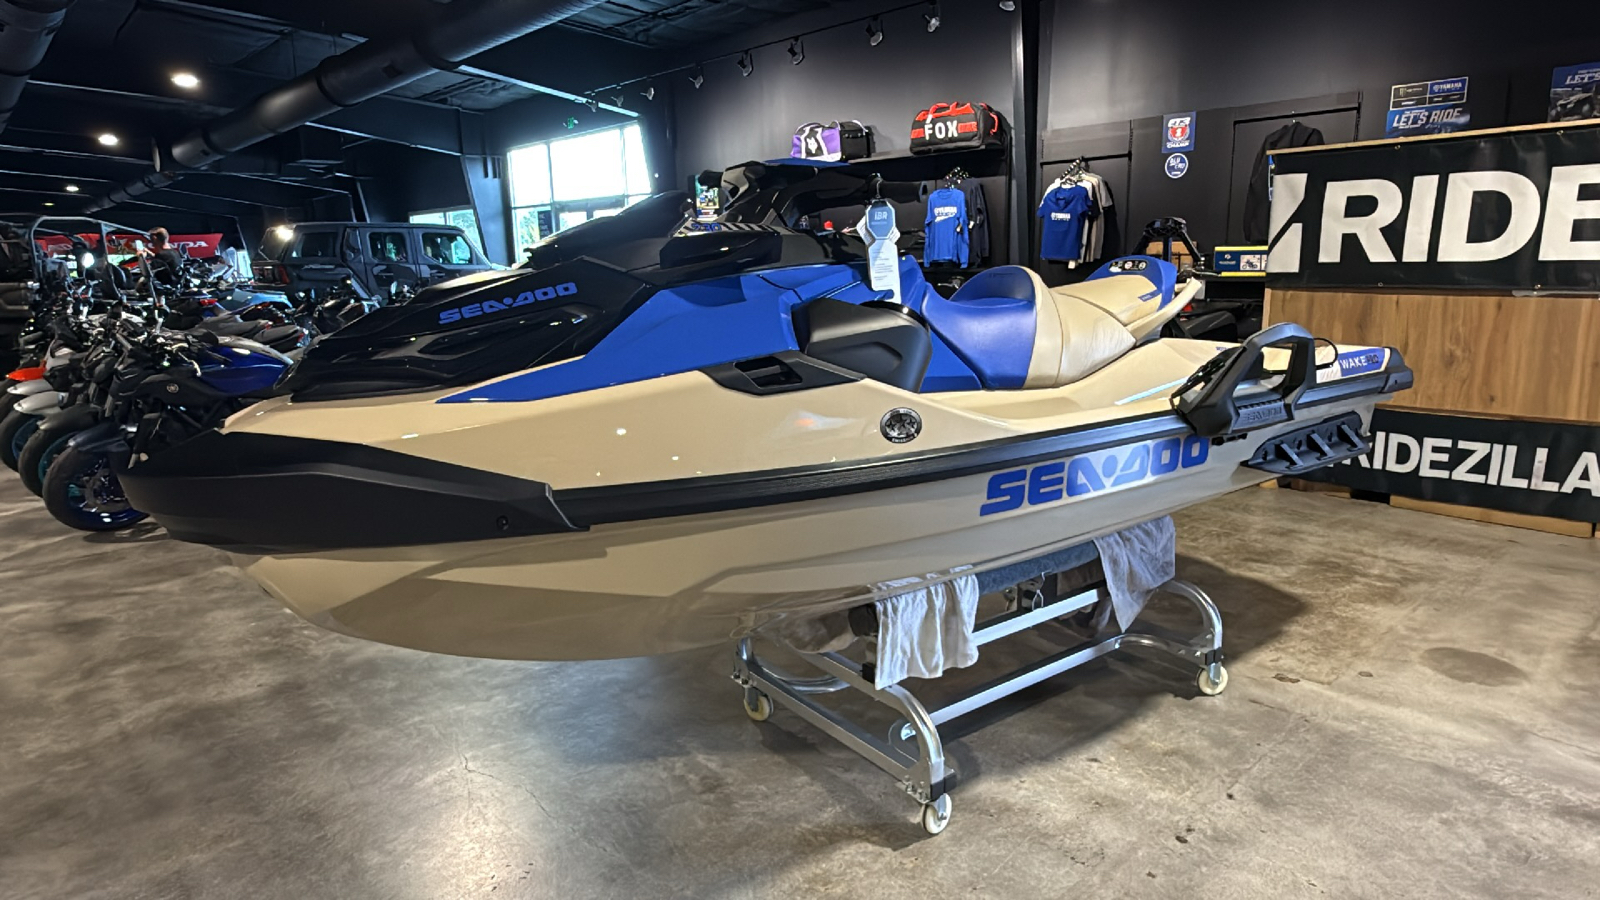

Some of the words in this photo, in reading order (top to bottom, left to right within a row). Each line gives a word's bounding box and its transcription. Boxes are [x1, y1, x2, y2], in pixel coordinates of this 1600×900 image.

[1392, 110, 1428, 128] LET'S
[1429, 108, 1464, 123] RIDE
[924, 120, 958, 141] FOX
[1340, 355, 1367, 369] WAKE
